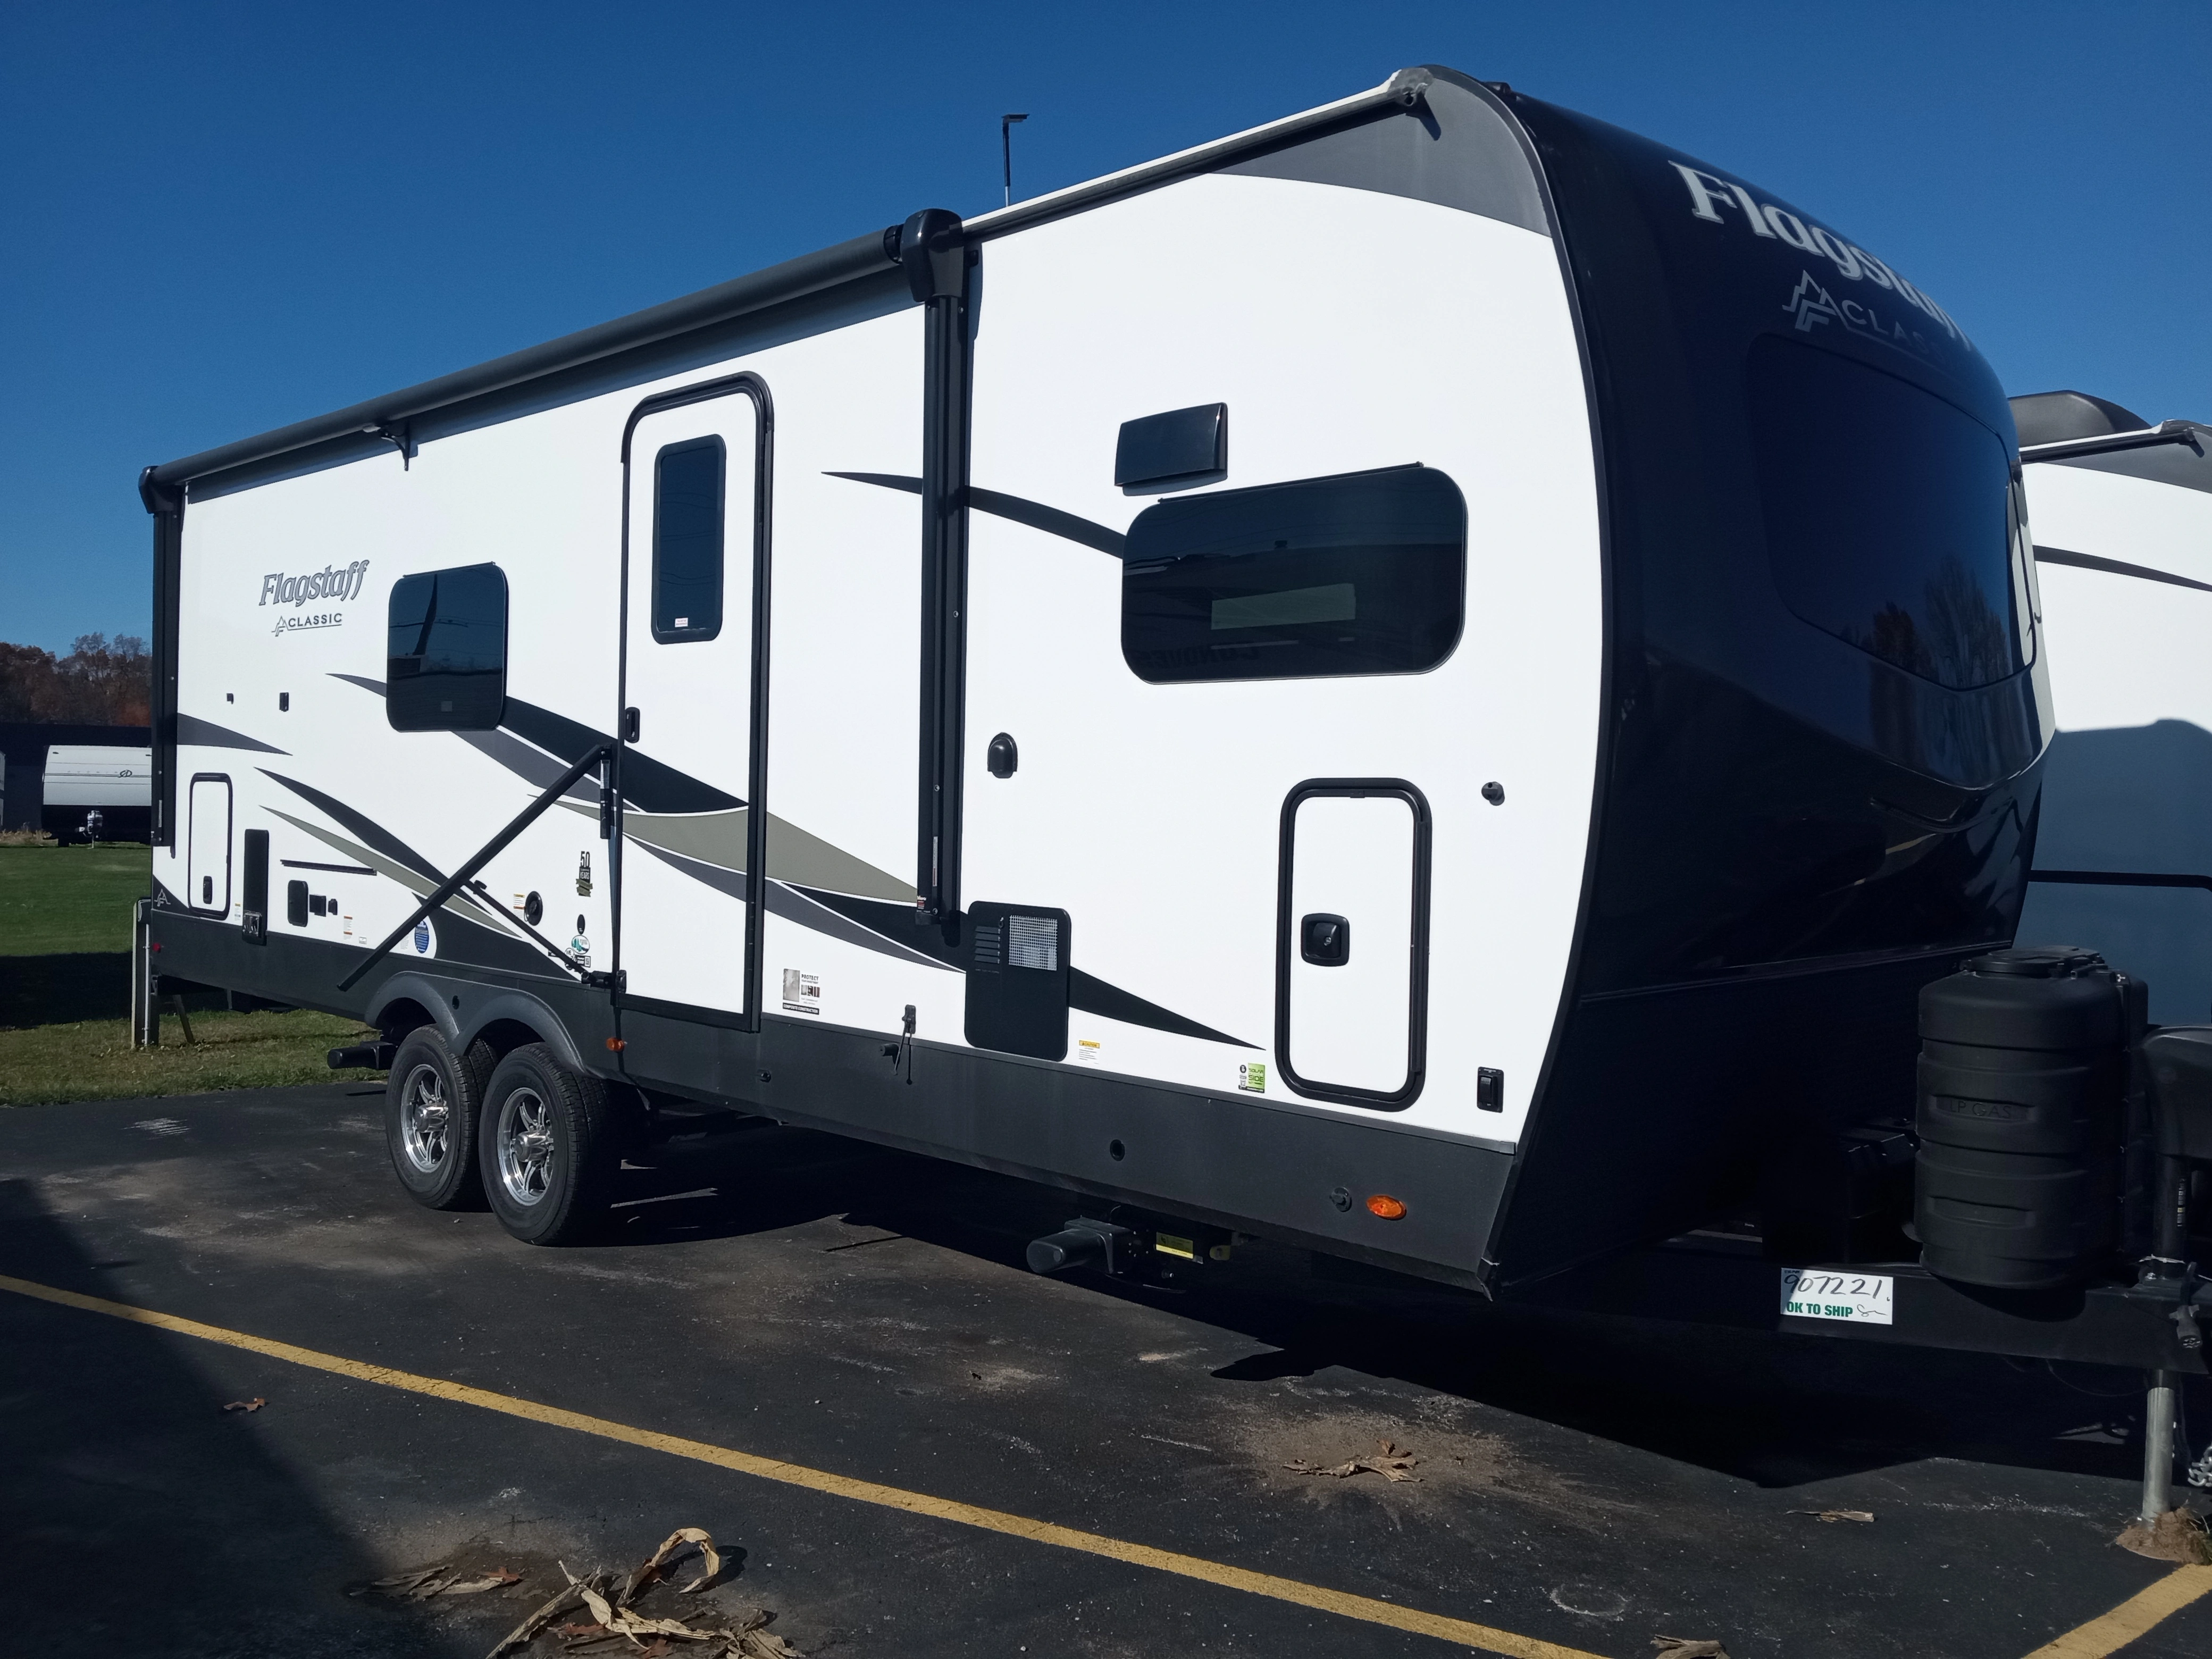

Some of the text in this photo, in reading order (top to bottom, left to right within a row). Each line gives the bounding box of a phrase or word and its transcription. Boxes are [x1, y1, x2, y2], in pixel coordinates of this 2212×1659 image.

[259, 559, 370, 607] Flagstaff
[288, 613, 342, 627] CLASSIC
[580, 851, 590, 867] 50
[1950, 1099, 2012, 1119] LP GAS
[1787, 1302, 1803, 1313] OK
[1806, 1303, 1821, 1314] TO
[1824, 1305, 1853, 1317] SHIP
